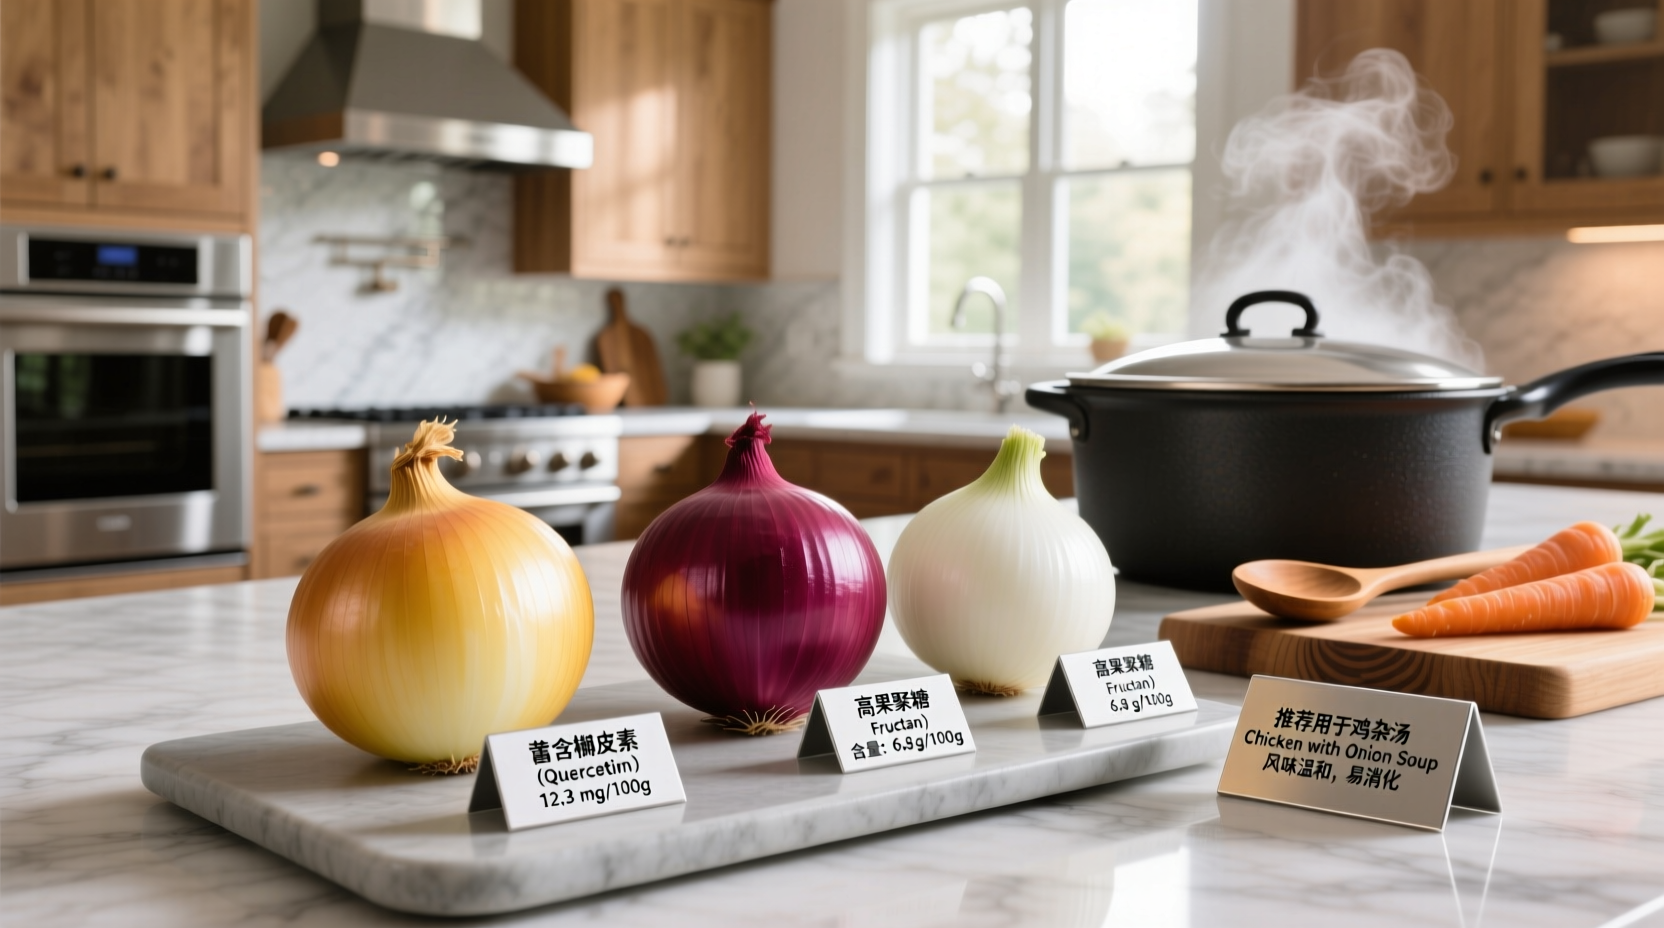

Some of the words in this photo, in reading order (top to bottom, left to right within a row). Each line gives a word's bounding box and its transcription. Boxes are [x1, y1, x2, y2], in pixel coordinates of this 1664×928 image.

[1273, 706, 1411, 746] 推荐用于鸡杂汤
[1244, 728, 1303, 752] Chicken
[1308, 738, 1341, 758] with
[1345, 742, 1393, 766] Onion
[1396, 749, 1439, 775] Soup
[579, 778, 652, 805] mg/100g
